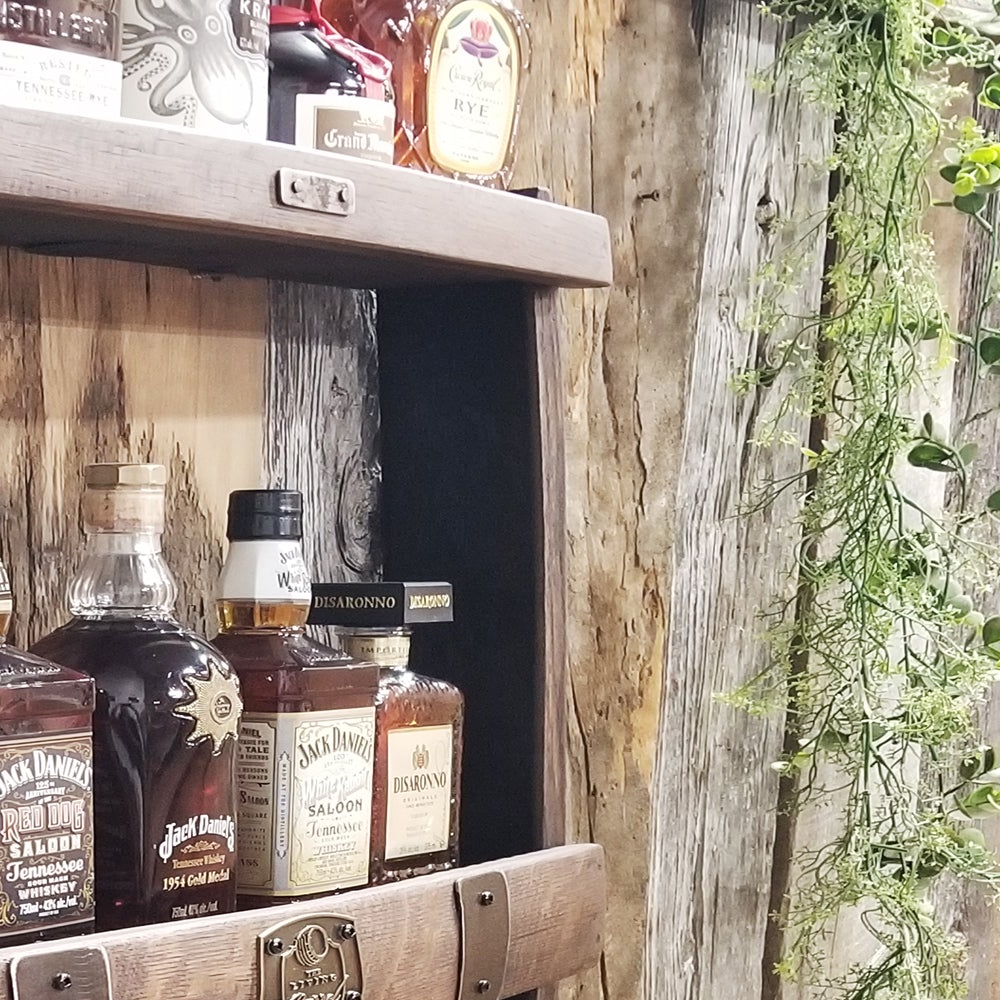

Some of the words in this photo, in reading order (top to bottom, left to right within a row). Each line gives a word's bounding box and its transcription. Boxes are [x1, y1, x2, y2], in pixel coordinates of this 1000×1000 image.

[454, 98, 489, 118] RYE
[324, 128, 367, 150] Grand
[314, 595, 396, 610] DISARONNO
[409, 594, 450, 609] DISARONNO
[246, 746, 269, 754] TALE
[297, 732, 330, 769] JACK
[332, 726, 373, 763] DANIEL'S
[32, 749, 93, 791] DANIEL'S
[393, 771, 447, 794] DISARONNO
[308, 798, 363, 818] SALOON
[0, 804, 45, 845] RED
[47, 799, 86, 834] DOG
[10, 833, 82, 860] SALOON
[6, 857, 84, 882] Tennessee
[162, 874, 186, 892] 1954
[187, 871, 207, 887] Gold
[207, 868, 230, 884] Medal
[18, 881, 78, 900] WHISKEY
